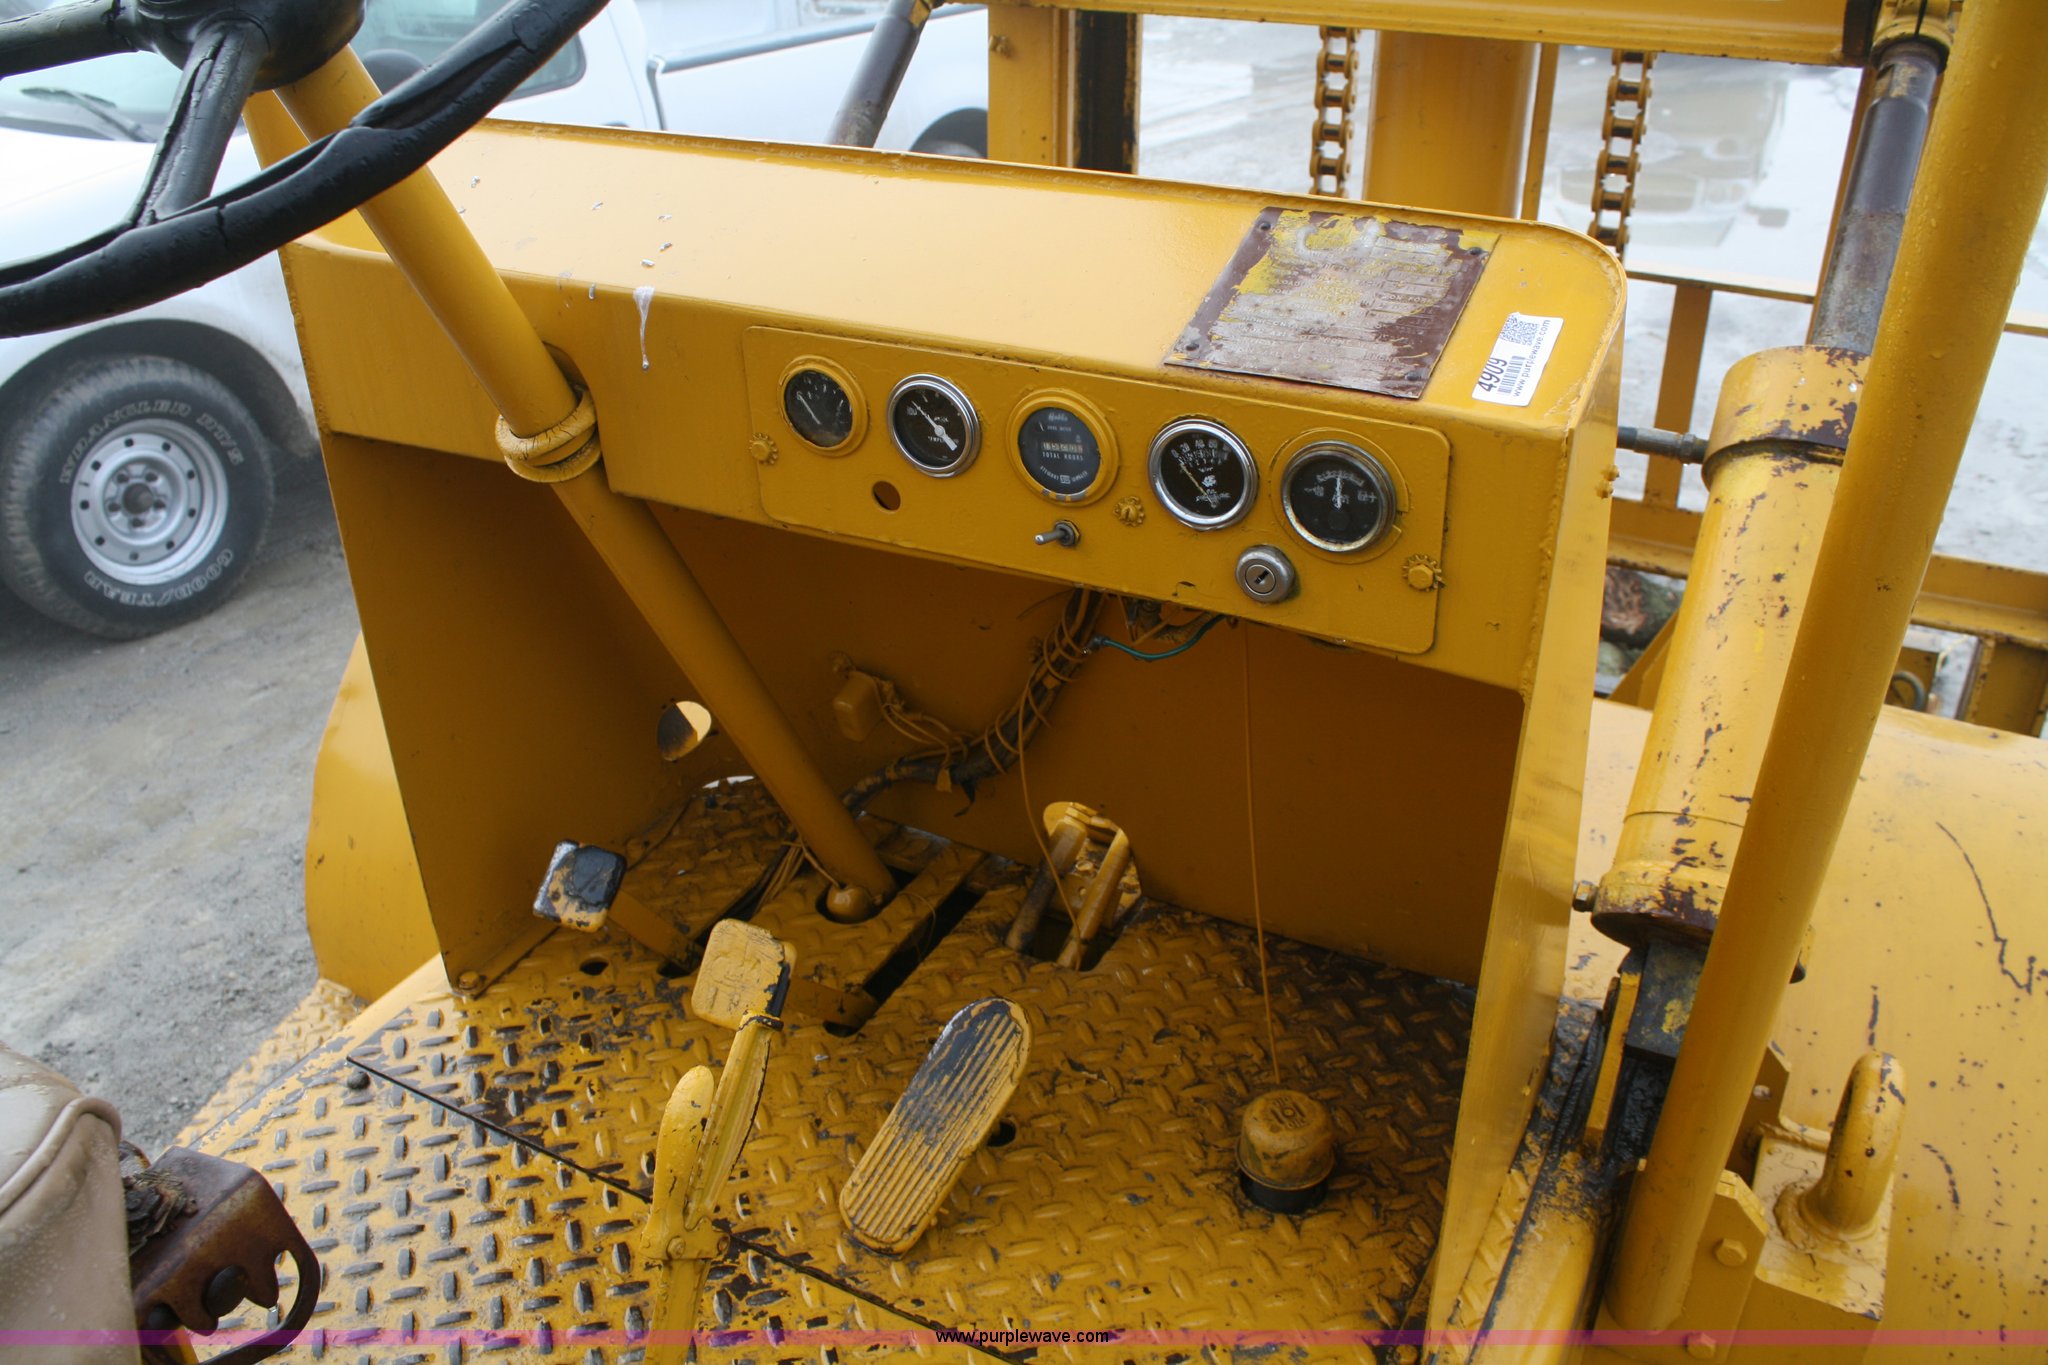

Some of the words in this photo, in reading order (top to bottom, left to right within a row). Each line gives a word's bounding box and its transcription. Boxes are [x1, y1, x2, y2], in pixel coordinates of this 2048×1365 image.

[1478, 357, 1507, 392] 4909
[59, 399, 193, 485] WRANGLER
[84, 548, 235, 608] GOODYEAR
